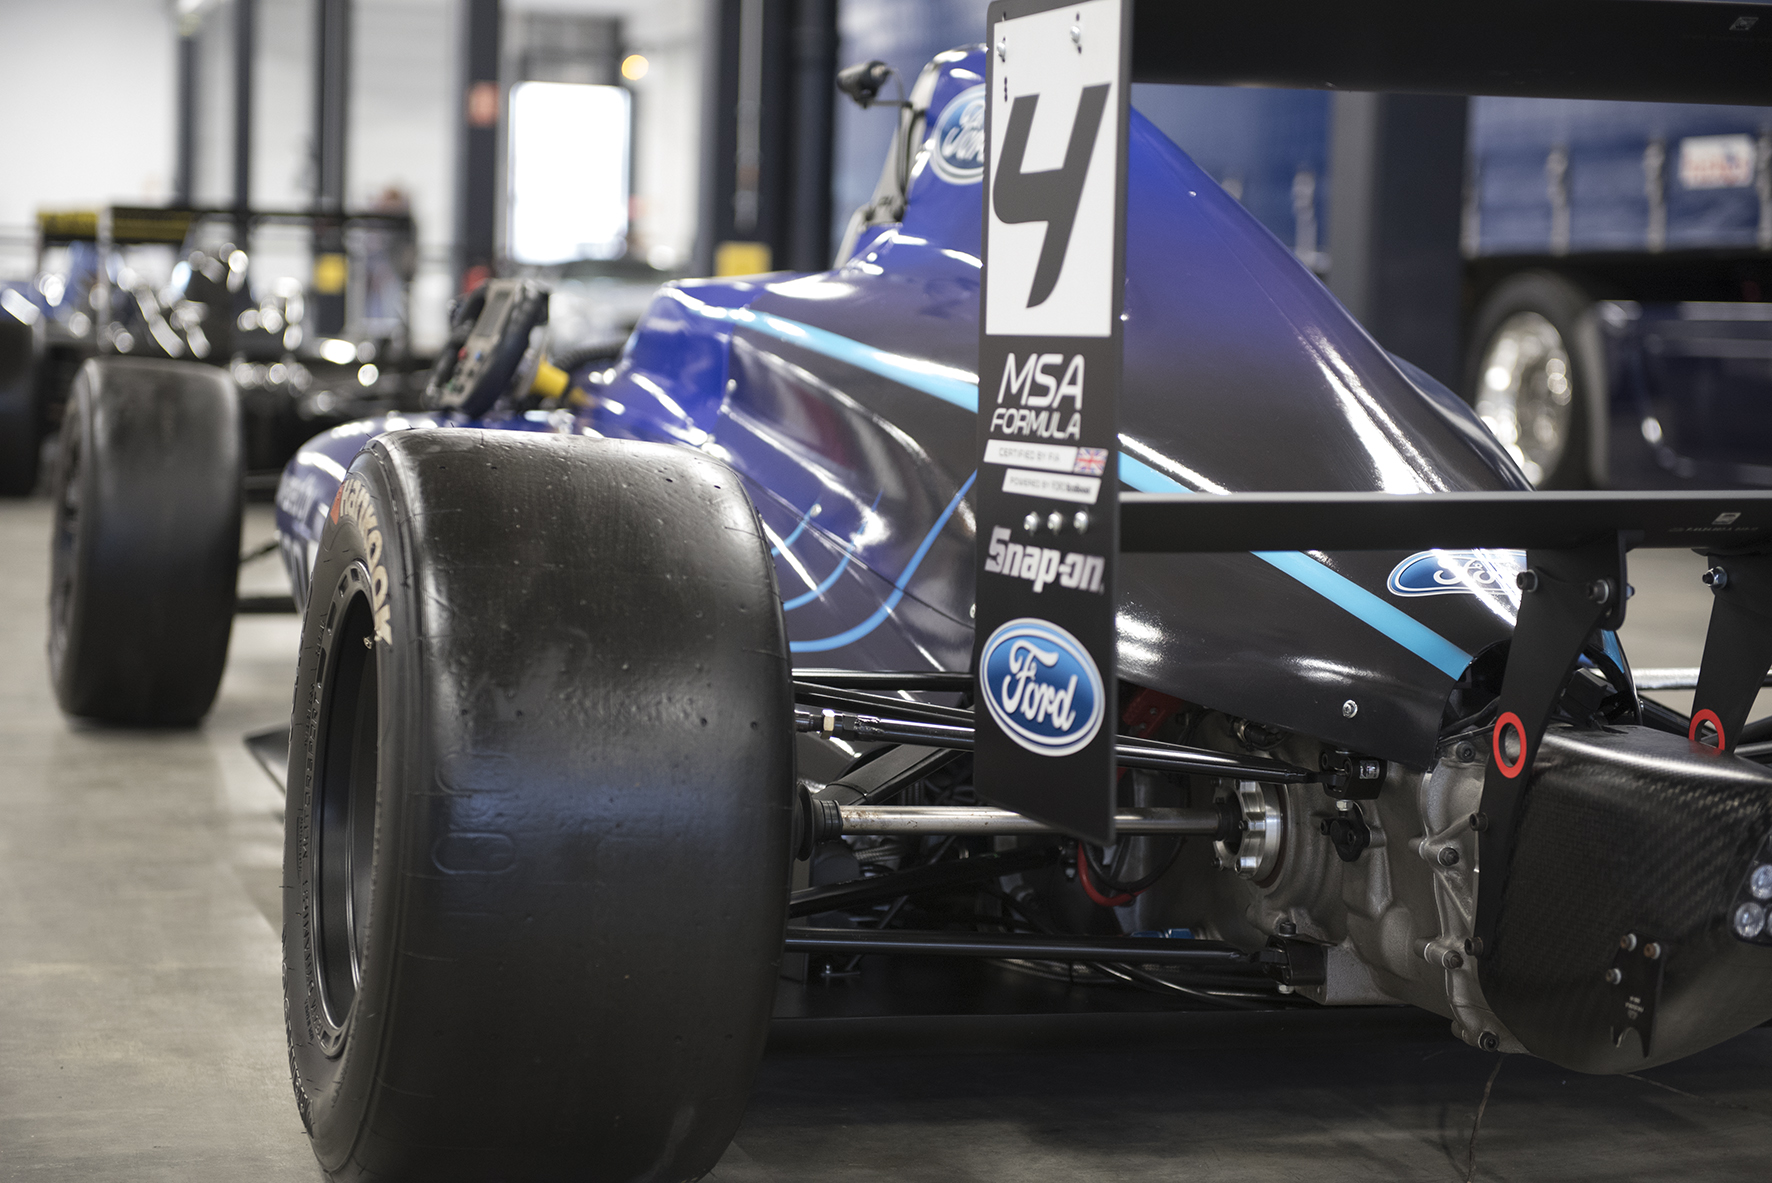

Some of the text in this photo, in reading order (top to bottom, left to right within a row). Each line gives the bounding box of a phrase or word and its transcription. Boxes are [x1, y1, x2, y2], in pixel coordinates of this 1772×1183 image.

[992, 82, 1112, 308] 4
[996, 352, 1085, 411] MSA
[990, 407, 1082, 441] FORMULA
[984, 525, 1105, 593] Snap-on
[1001, 639, 1079, 732] Ford
